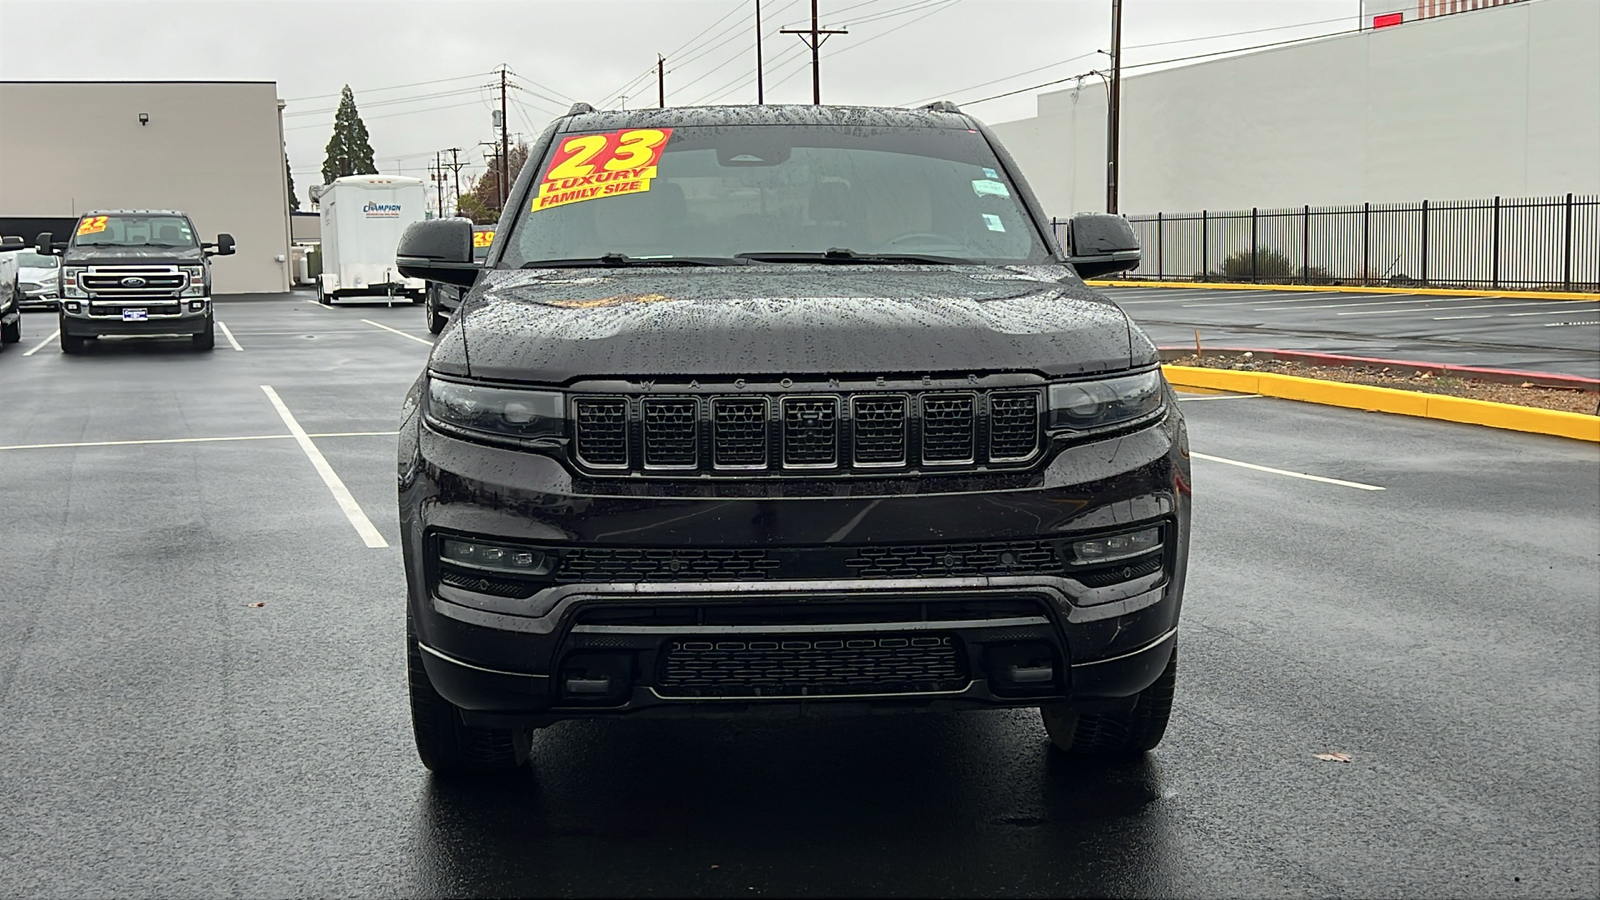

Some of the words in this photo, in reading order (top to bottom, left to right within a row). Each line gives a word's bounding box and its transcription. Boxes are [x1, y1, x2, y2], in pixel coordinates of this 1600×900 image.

[548, 129, 666, 179] 23
[547, 167, 646, 193] LUXURY
[540, 186, 601, 207] FAMILY
[603, 181, 641, 194] SIZE
[363, 202, 401, 212] CHAMPION
[80, 216, 107, 229] 22
[474, 231, 495, 241] 20
[640, 374, 978, 391] WAGONEER
